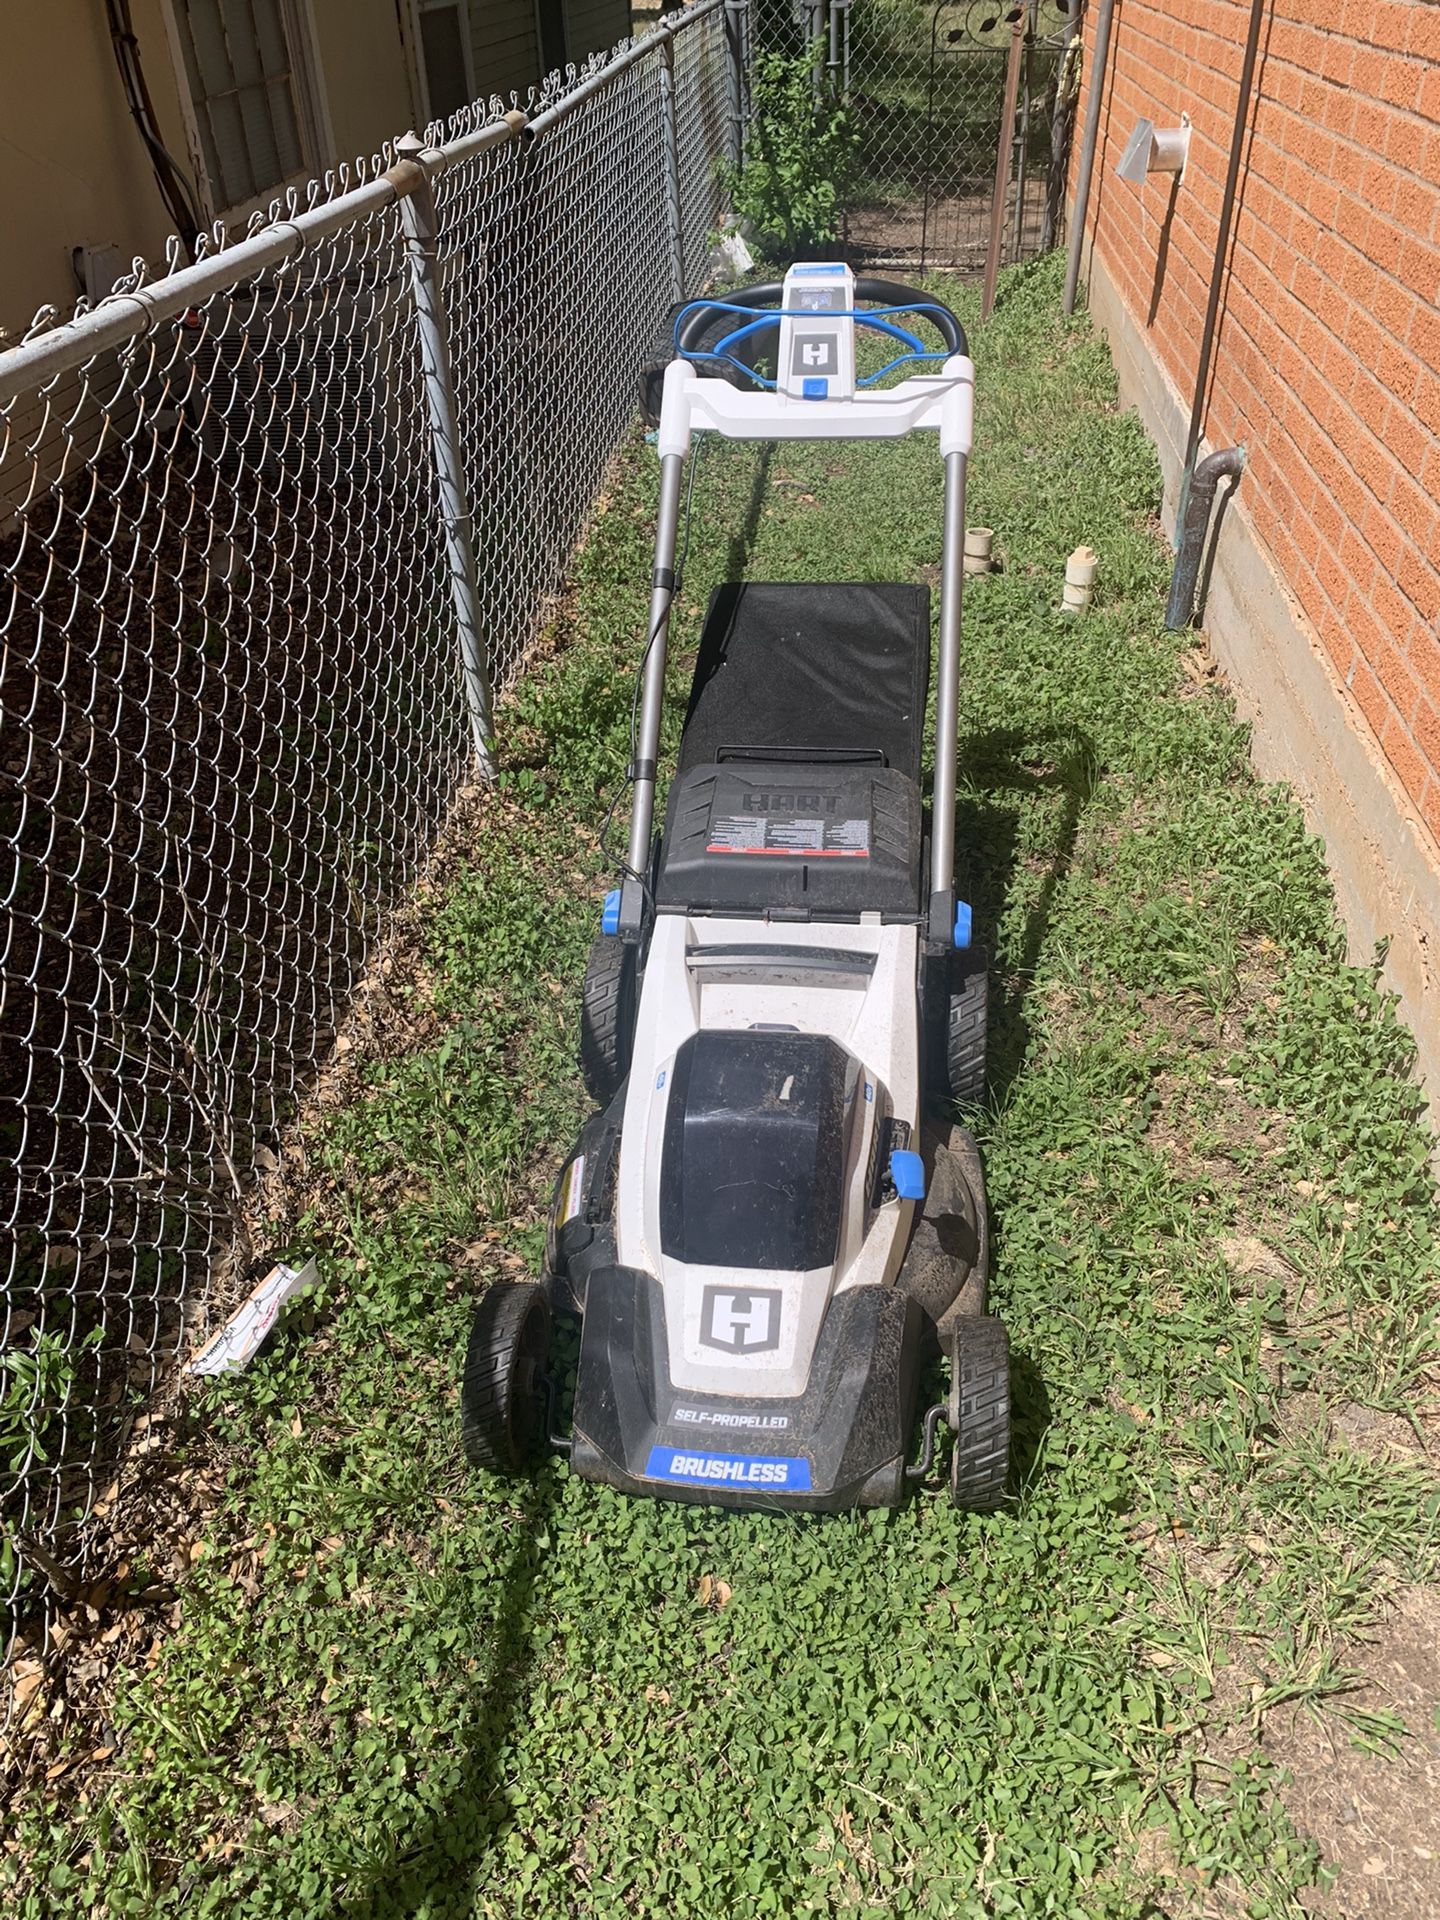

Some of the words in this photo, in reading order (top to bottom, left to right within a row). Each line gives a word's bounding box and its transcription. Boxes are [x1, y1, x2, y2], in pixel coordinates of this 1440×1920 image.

[803, 343, 828, 366] H
[743, 793, 841, 814] HART
[711, 1294, 771, 1345] H
[674, 1408, 788, 1429] SELF-PROPELLED
[669, 1455, 788, 1483] BRUSHLESS
